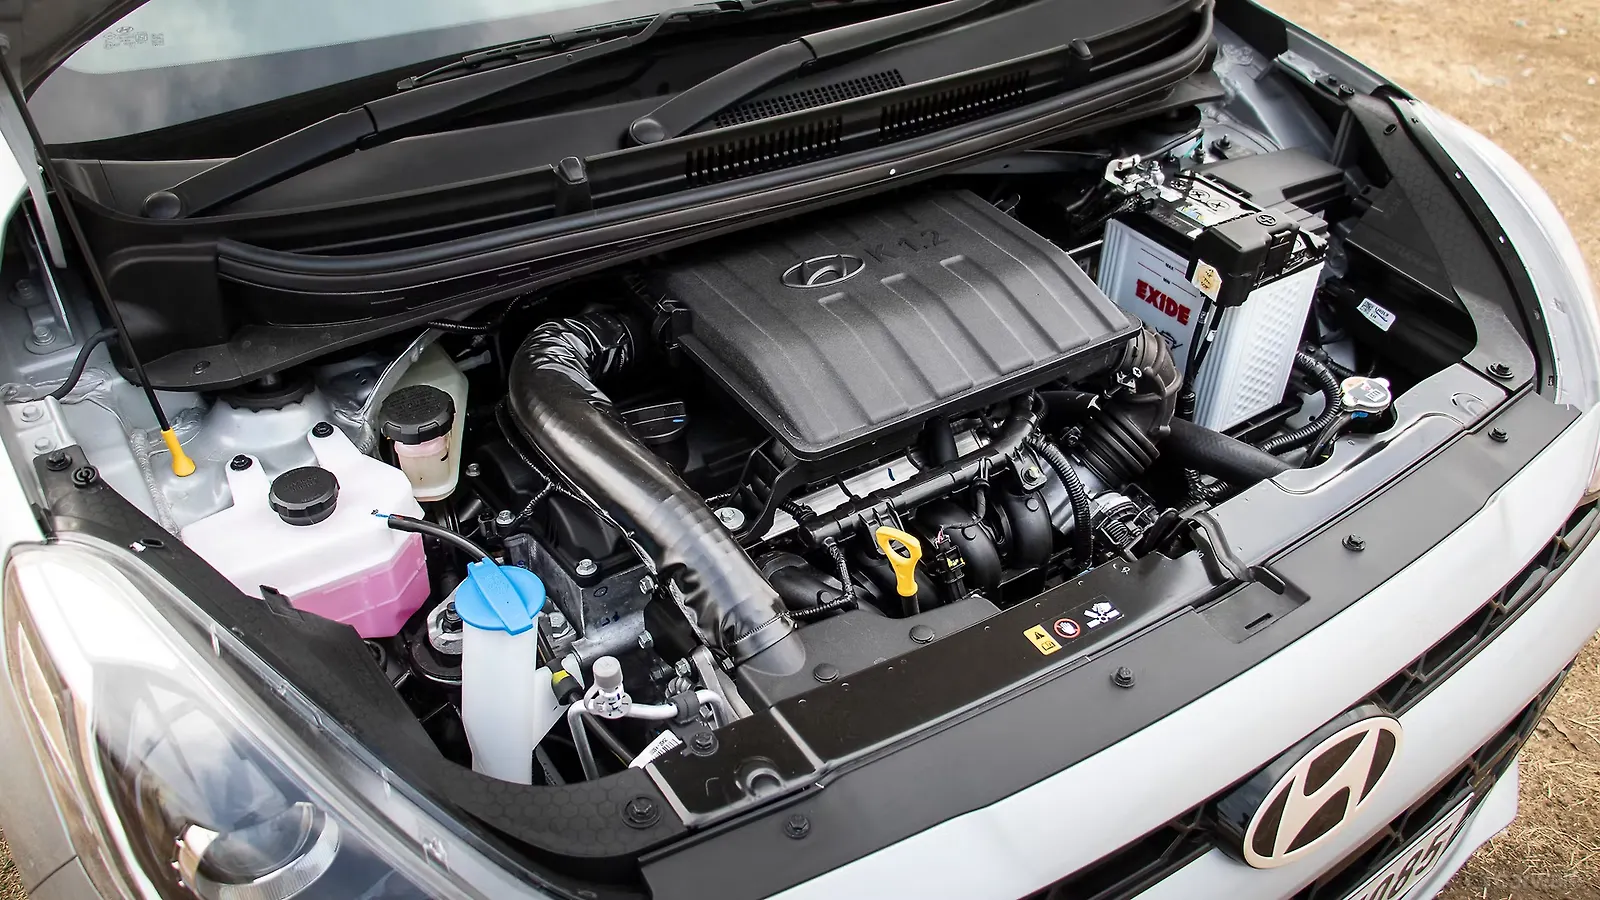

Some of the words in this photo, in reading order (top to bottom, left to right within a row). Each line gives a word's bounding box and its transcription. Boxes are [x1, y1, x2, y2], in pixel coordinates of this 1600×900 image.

[863, 243, 897, 263] K
[897, 229, 950, 252] 1.2
[1136, 279, 1191, 326] EXIDE
[1359, 821, 1453, 900] 085
